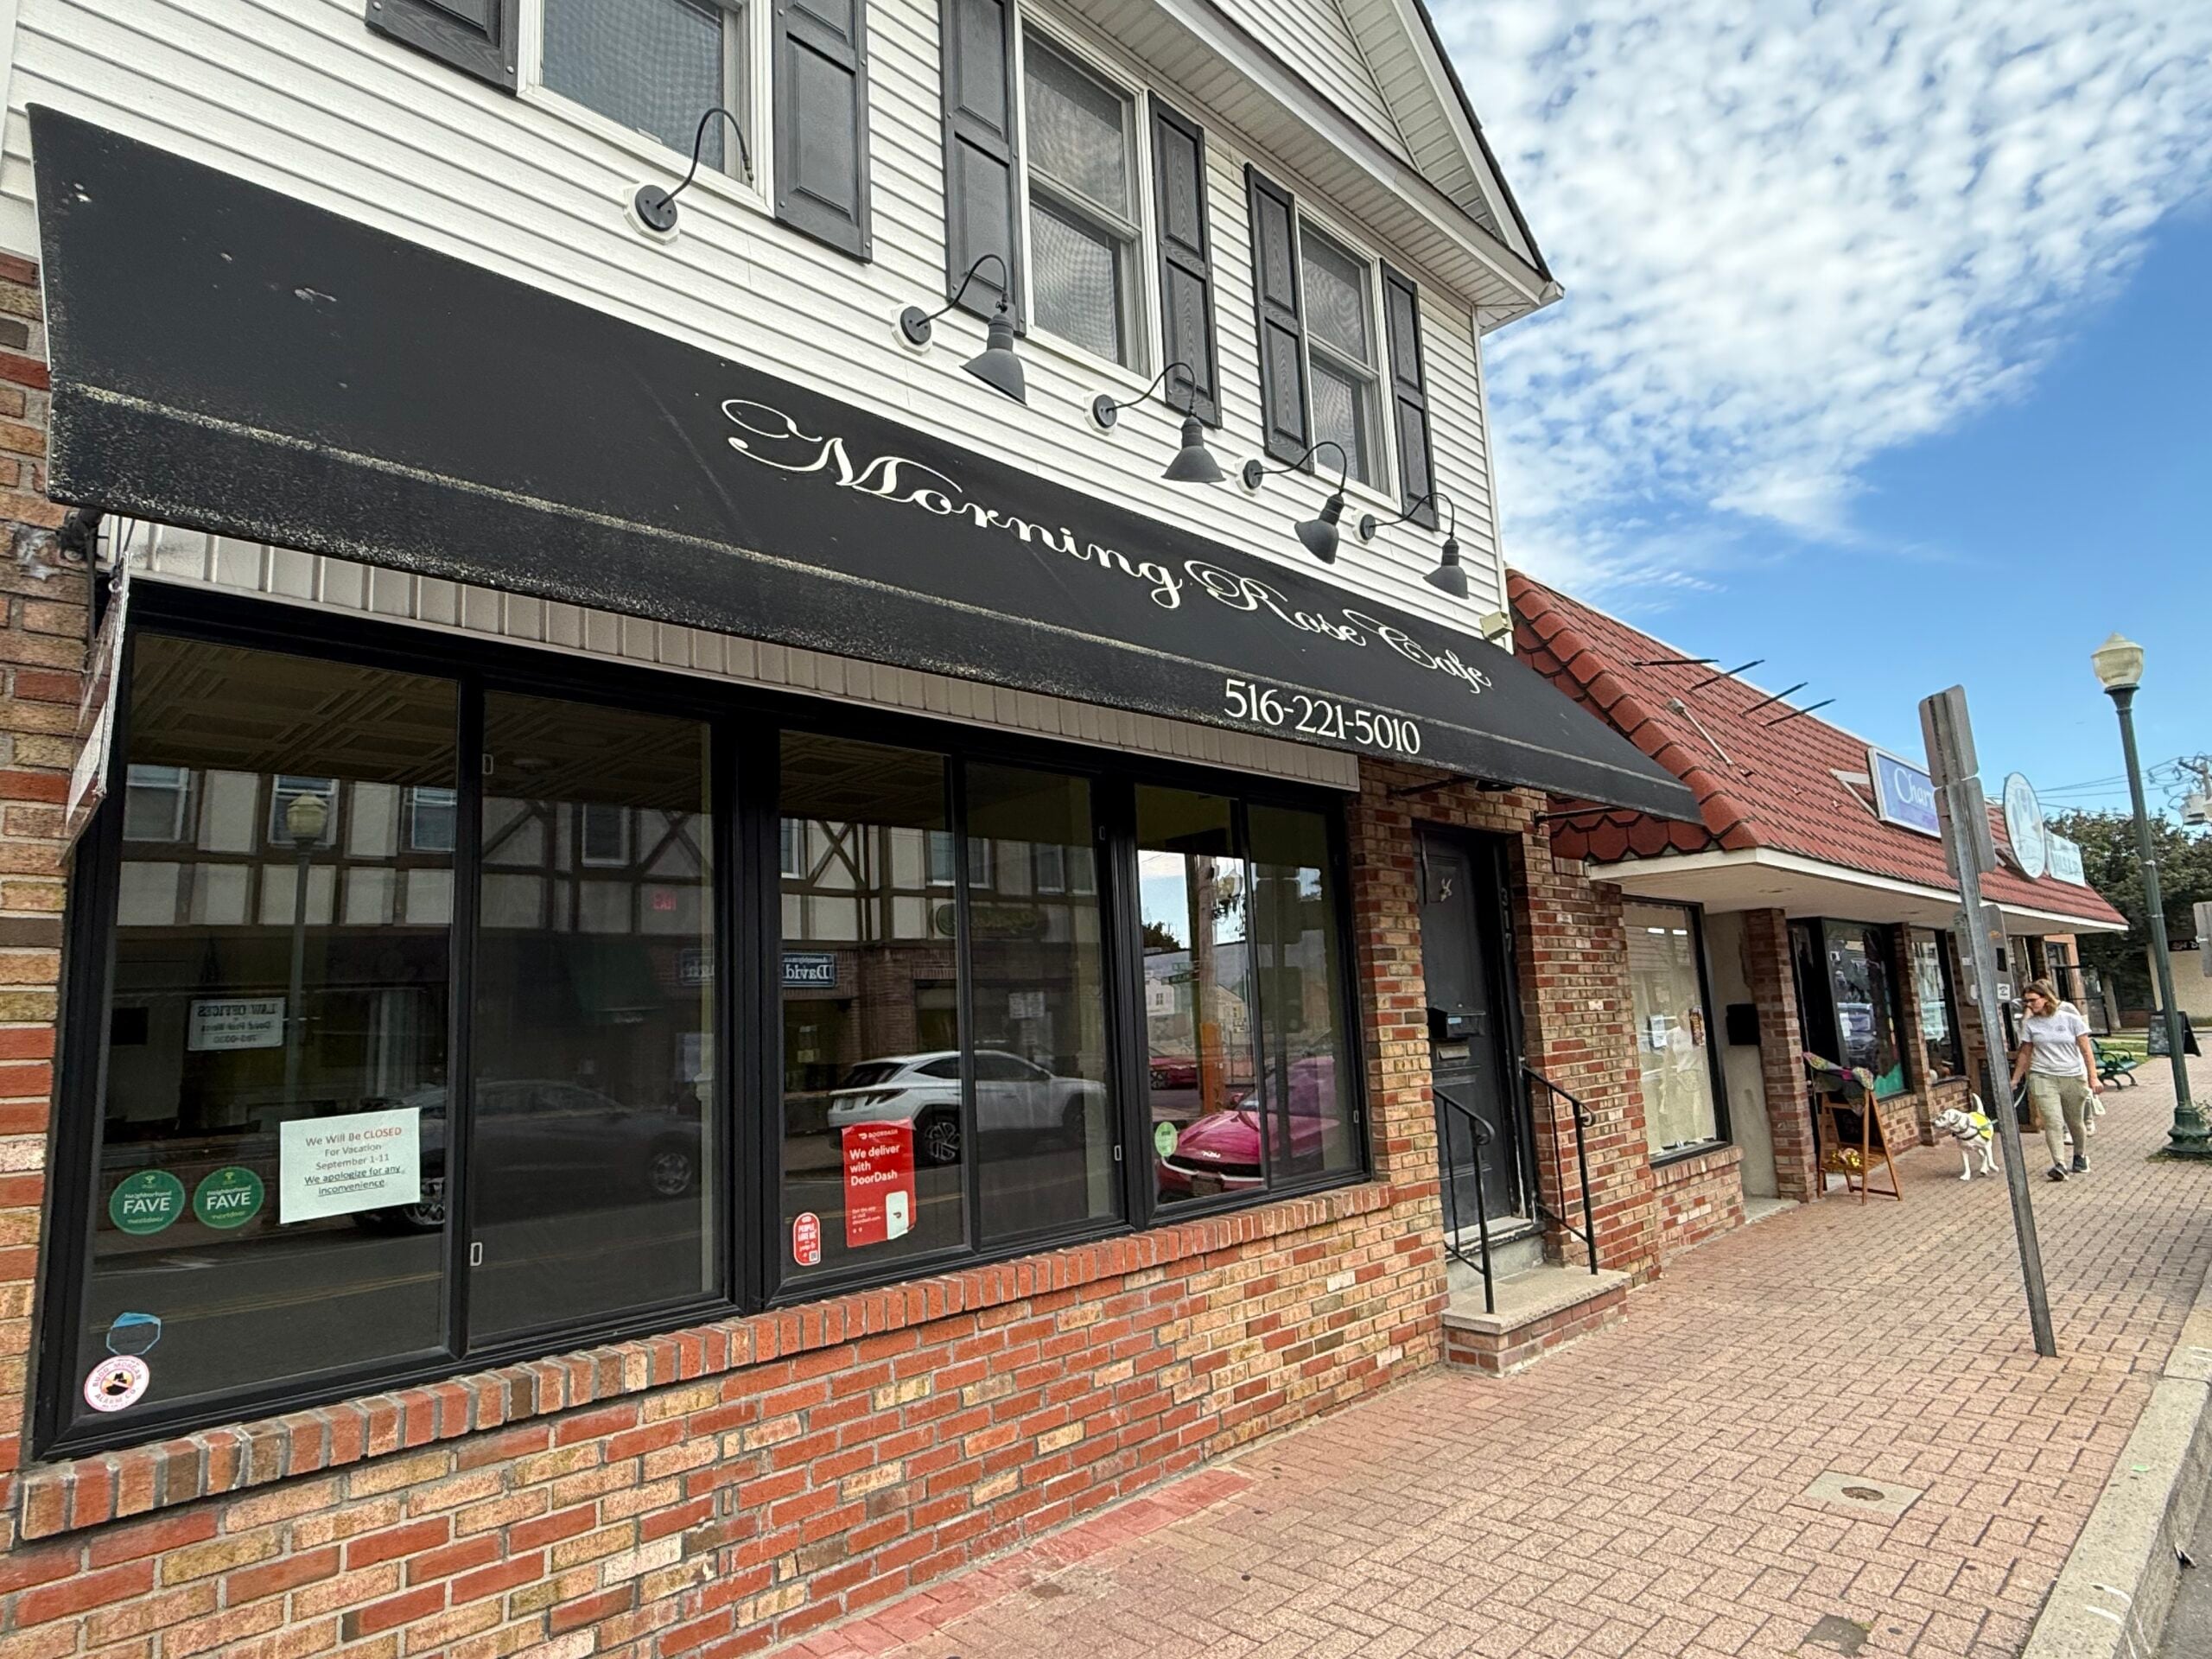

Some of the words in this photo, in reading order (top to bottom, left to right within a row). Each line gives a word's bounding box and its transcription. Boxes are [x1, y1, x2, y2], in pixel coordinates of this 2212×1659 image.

[721, 398, 1184, 610] Morning
[1184, 559, 1367, 647] Rose
[1342, 607, 1493, 694] Cafe
[1224, 678, 1421, 755] 516-221-5010
[306, 1137, 322, 1147] We
[326, 1134, 345, 1144] Will
[348, 1132, 361, 1142] Be
[364, 1127, 402, 1140] CLOSED
[325, 1147, 340, 1157] For
[342, 1143, 382, 1154] Vacation
[849, 1147, 867, 1160] We
[868, 1144, 900, 1157] deliver
[315, 1157, 366, 1170] September
[370, 1154, 390, 1164] 1-11
[849, 1160, 871, 1173] with
[304, 1175, 321, 1186] We
[323, 1170, 367, 1183] apologize
[369, 1166, 382, 1176] for
[851, 1170, 898, 1186] DoorDash
[123, 1197, 172, 1214] FAVE
[207, 1192, 251, 1211] FAVE
